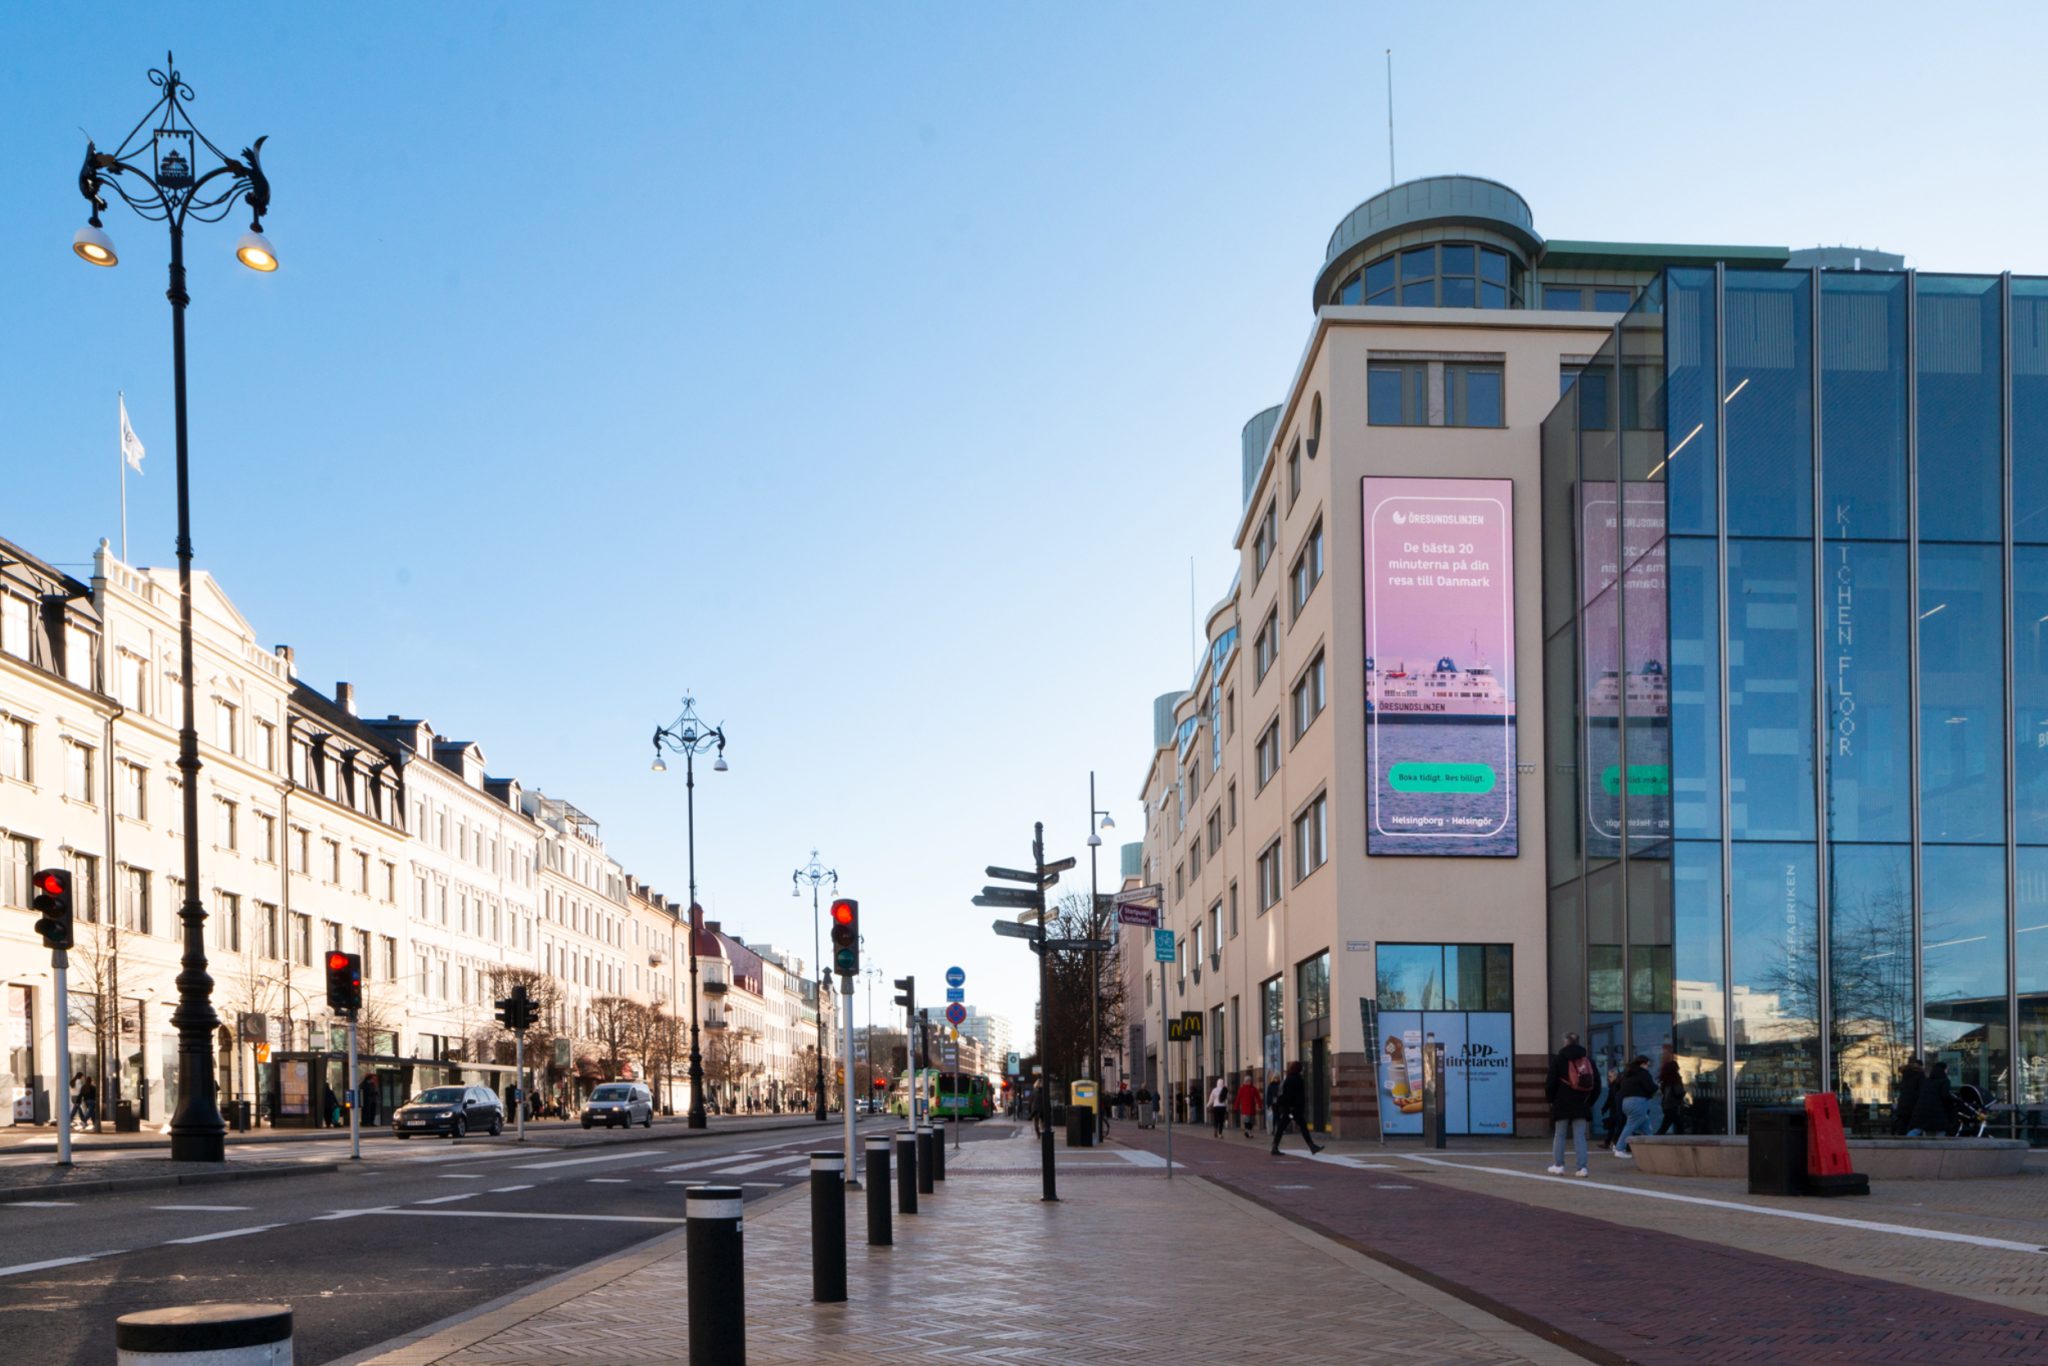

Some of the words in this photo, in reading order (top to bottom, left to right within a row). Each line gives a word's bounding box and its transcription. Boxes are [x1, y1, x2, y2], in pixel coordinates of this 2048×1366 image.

[1408, 511, 1485, 525] ÖRESUNDSLINJEN
[1403, 542, 1420, 553] De
[1422, 542, 1455, 554] bästa
[1459, 543, 1474, 554] 20
[1388, 558, 1450, 570] minuterna
[1453, 560, 1468, 572] på
[1470, 560, 1490, 571] din
[1388, 577, 1414, 586] resa
[1417, 576, 1434, 586] till
[1437, 576, 1490, 588] Danmark
[1379, 702, 1446, 711] ÖRESUNDSLINJEN
[1839, 656, 1855, 757] FLOOR
[1398, 773, 1418, 781] Boka
[1445, 774, 1458, 782] Res
[1392, 816, 1443, 826] Helsingborg
[1452, 816, 1493, 827] Helsingör
